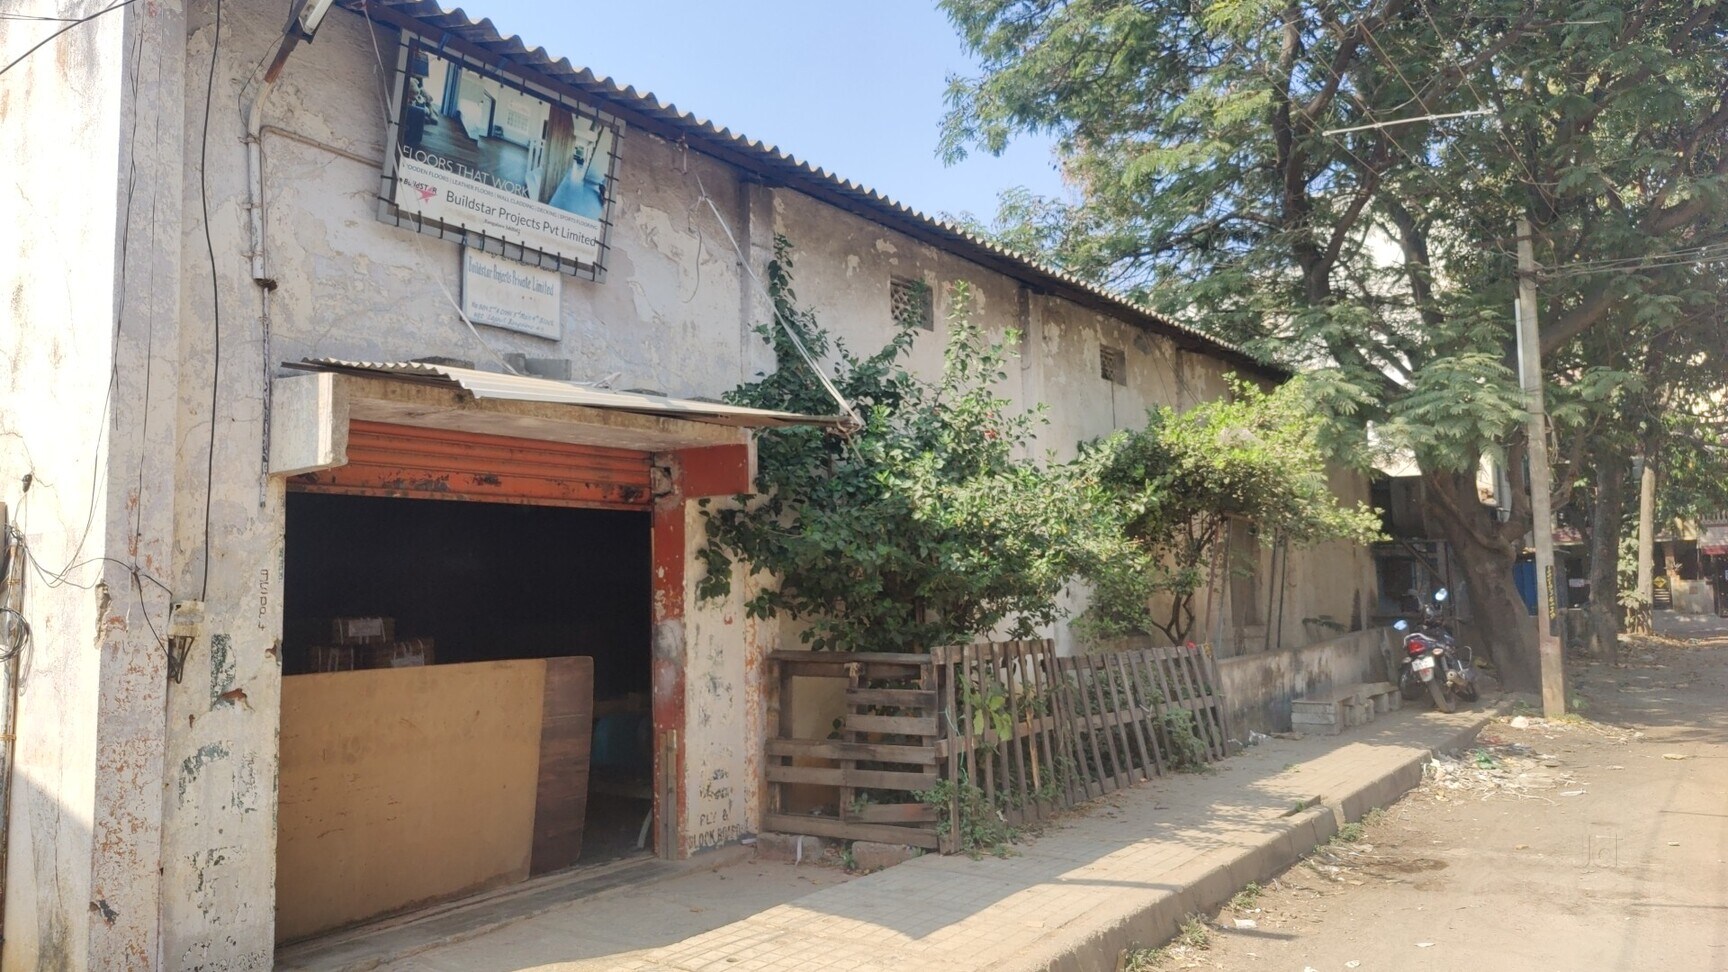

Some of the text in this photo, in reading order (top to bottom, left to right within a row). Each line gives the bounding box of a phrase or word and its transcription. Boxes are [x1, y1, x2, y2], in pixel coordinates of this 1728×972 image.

[403, 145, 530, 199] FLOORS THAT WORK
[428, 170, 449, 182] FLOORS
[452, 178, 475, 192] LEATHER
[475, 186, 494, 198] FLOORS
[497, 193, 510, 203] WALL
[510, 197, 535, 210] CLADDING
[446, 190, 597, 247] Buildstar Projects Pvt Limited
[468, 255, 493, 279] Buildstar
[512, 269, 531, 290] Private
[532, 275, 554, 296] Limited
